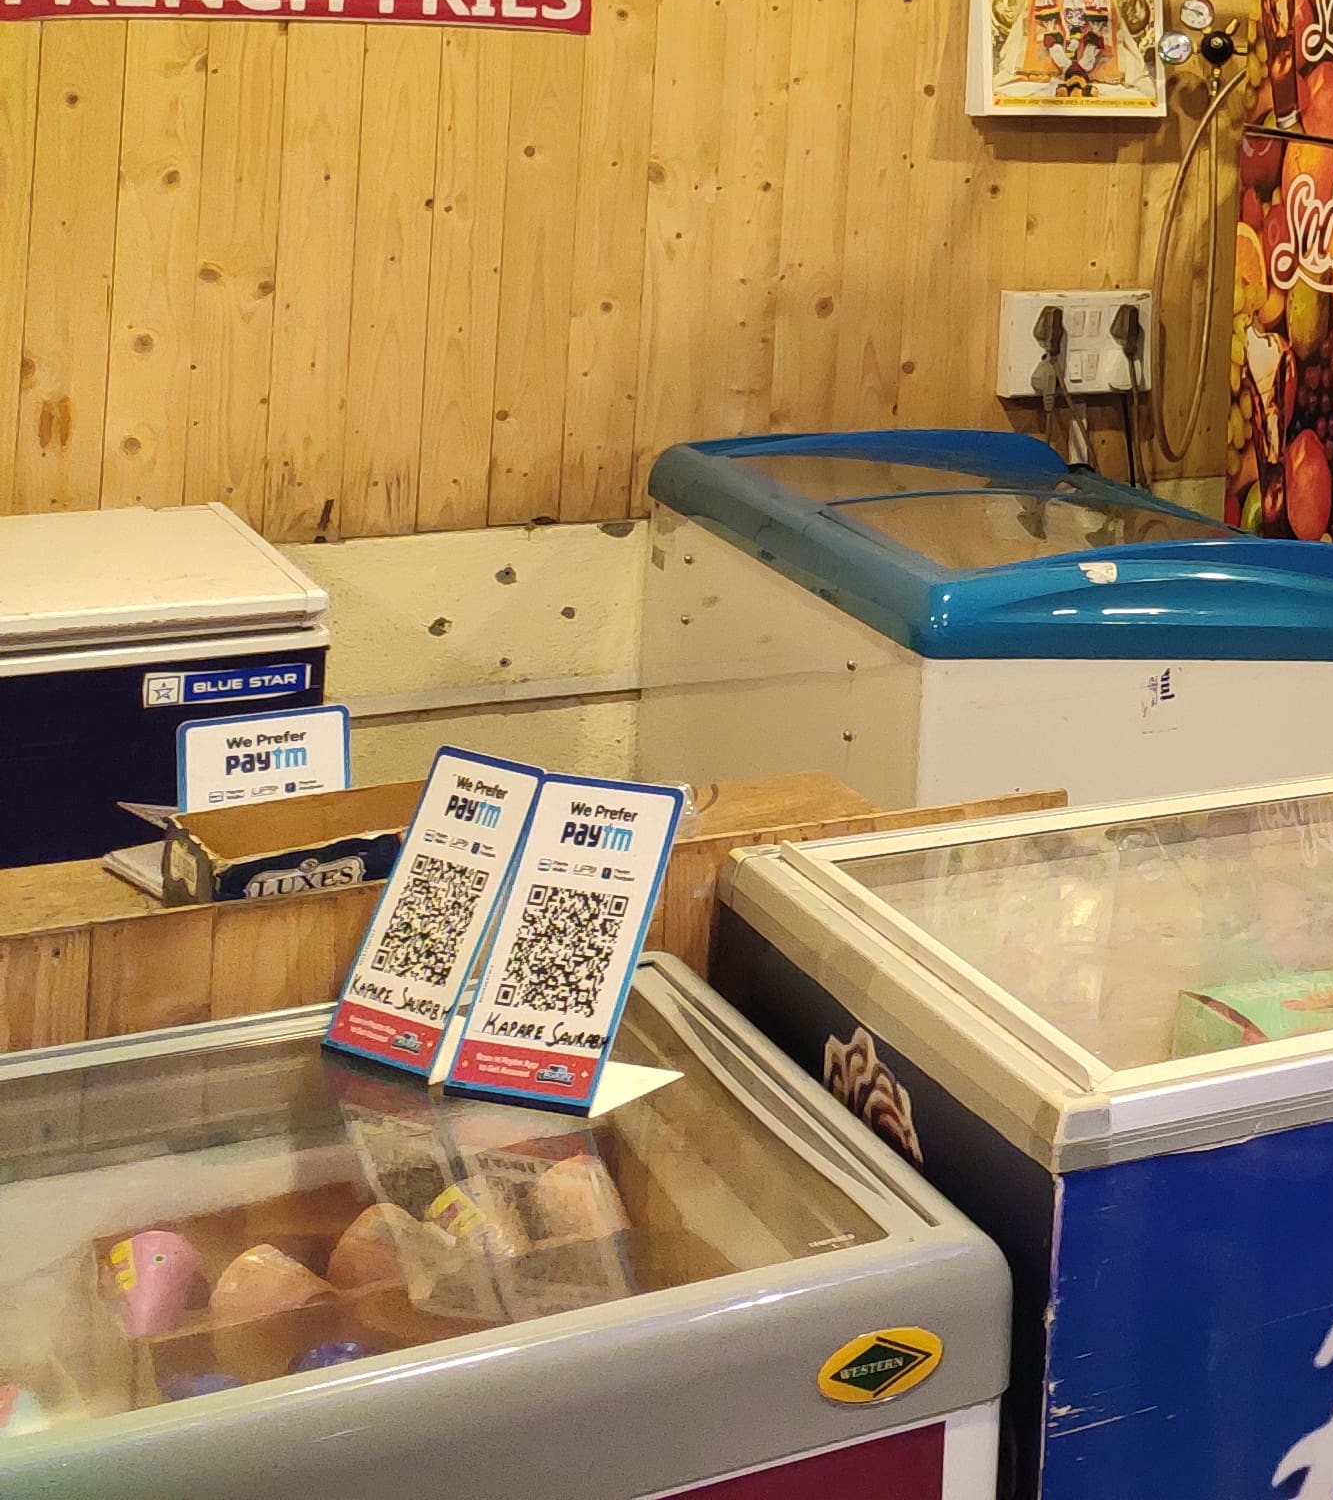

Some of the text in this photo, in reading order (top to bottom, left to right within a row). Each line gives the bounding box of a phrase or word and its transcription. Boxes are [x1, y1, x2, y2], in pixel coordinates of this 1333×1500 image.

[193, 673, 297, 694] BLUE STAR
[226, 731, 306, 750] We Prefer
[456, 775, 508, 800] We Prefer
[571, 801, 638, 823] We Prefer
[840, 1356, 904, 1380] WESTERN
